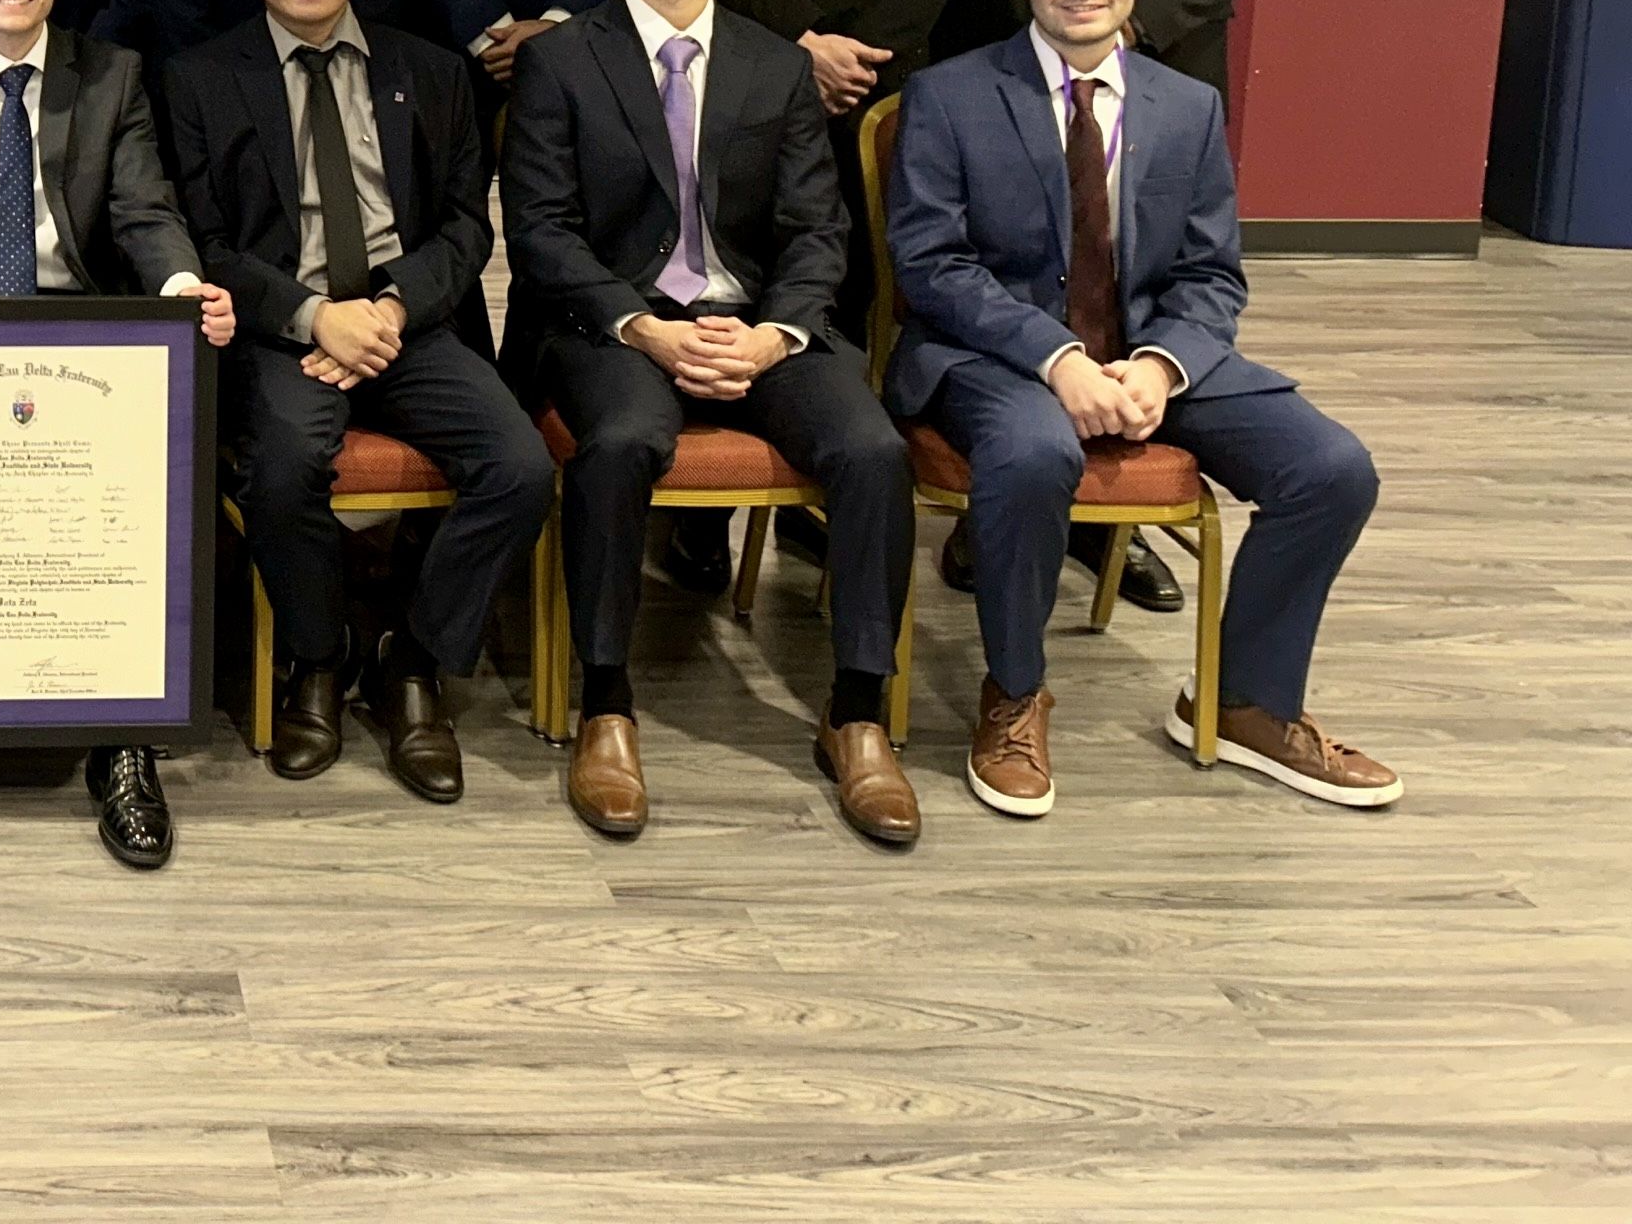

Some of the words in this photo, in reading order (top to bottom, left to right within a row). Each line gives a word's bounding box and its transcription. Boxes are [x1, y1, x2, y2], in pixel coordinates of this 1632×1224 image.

[23, 362, 53, 379] Delta
[55, 364, 113, 397] Fraternity
[61, 462, 92, 471] University
[19, 597, 37, 608] Zeta
